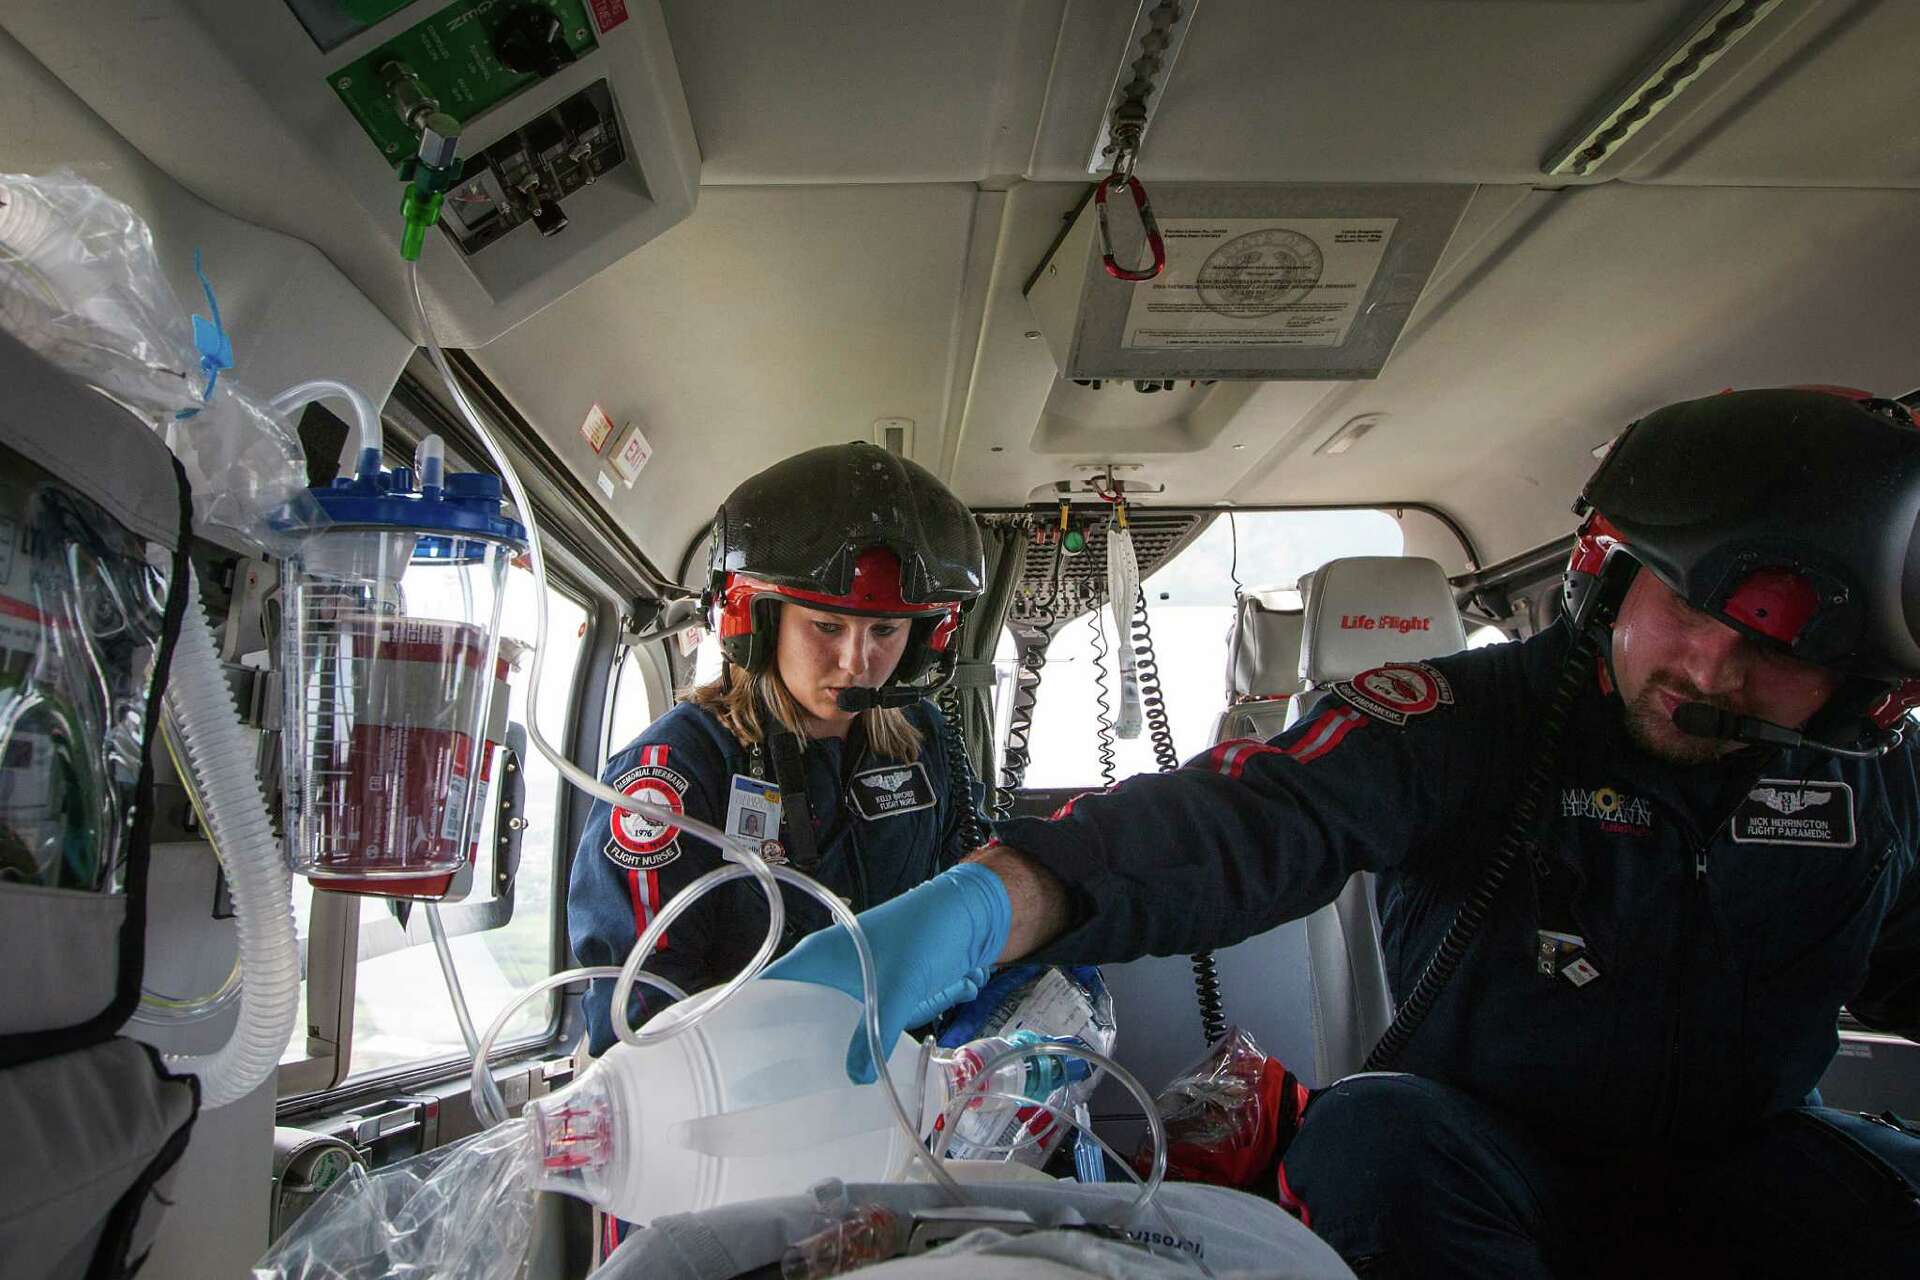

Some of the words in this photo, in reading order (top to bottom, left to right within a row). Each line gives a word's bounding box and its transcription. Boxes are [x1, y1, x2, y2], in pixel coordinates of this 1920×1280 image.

[1341, 615, 1375, 630] Life
[1379, 616, 1430, 633] Flight
[617, 768, 650, 789] MEMORIAL
[652, 768, 686, 791] HERMANN
[1771, 818, 1829, 830] HERRINGTON
[635, 829, 652, 838] 1976
[1747, 826, 1776, 836] FLIGHT
[1778, 828, 1831, 840] PARAMEDIC
[611, 847, 640, 865] FLIGHT
[642, 847, 674, 865] NURSE
